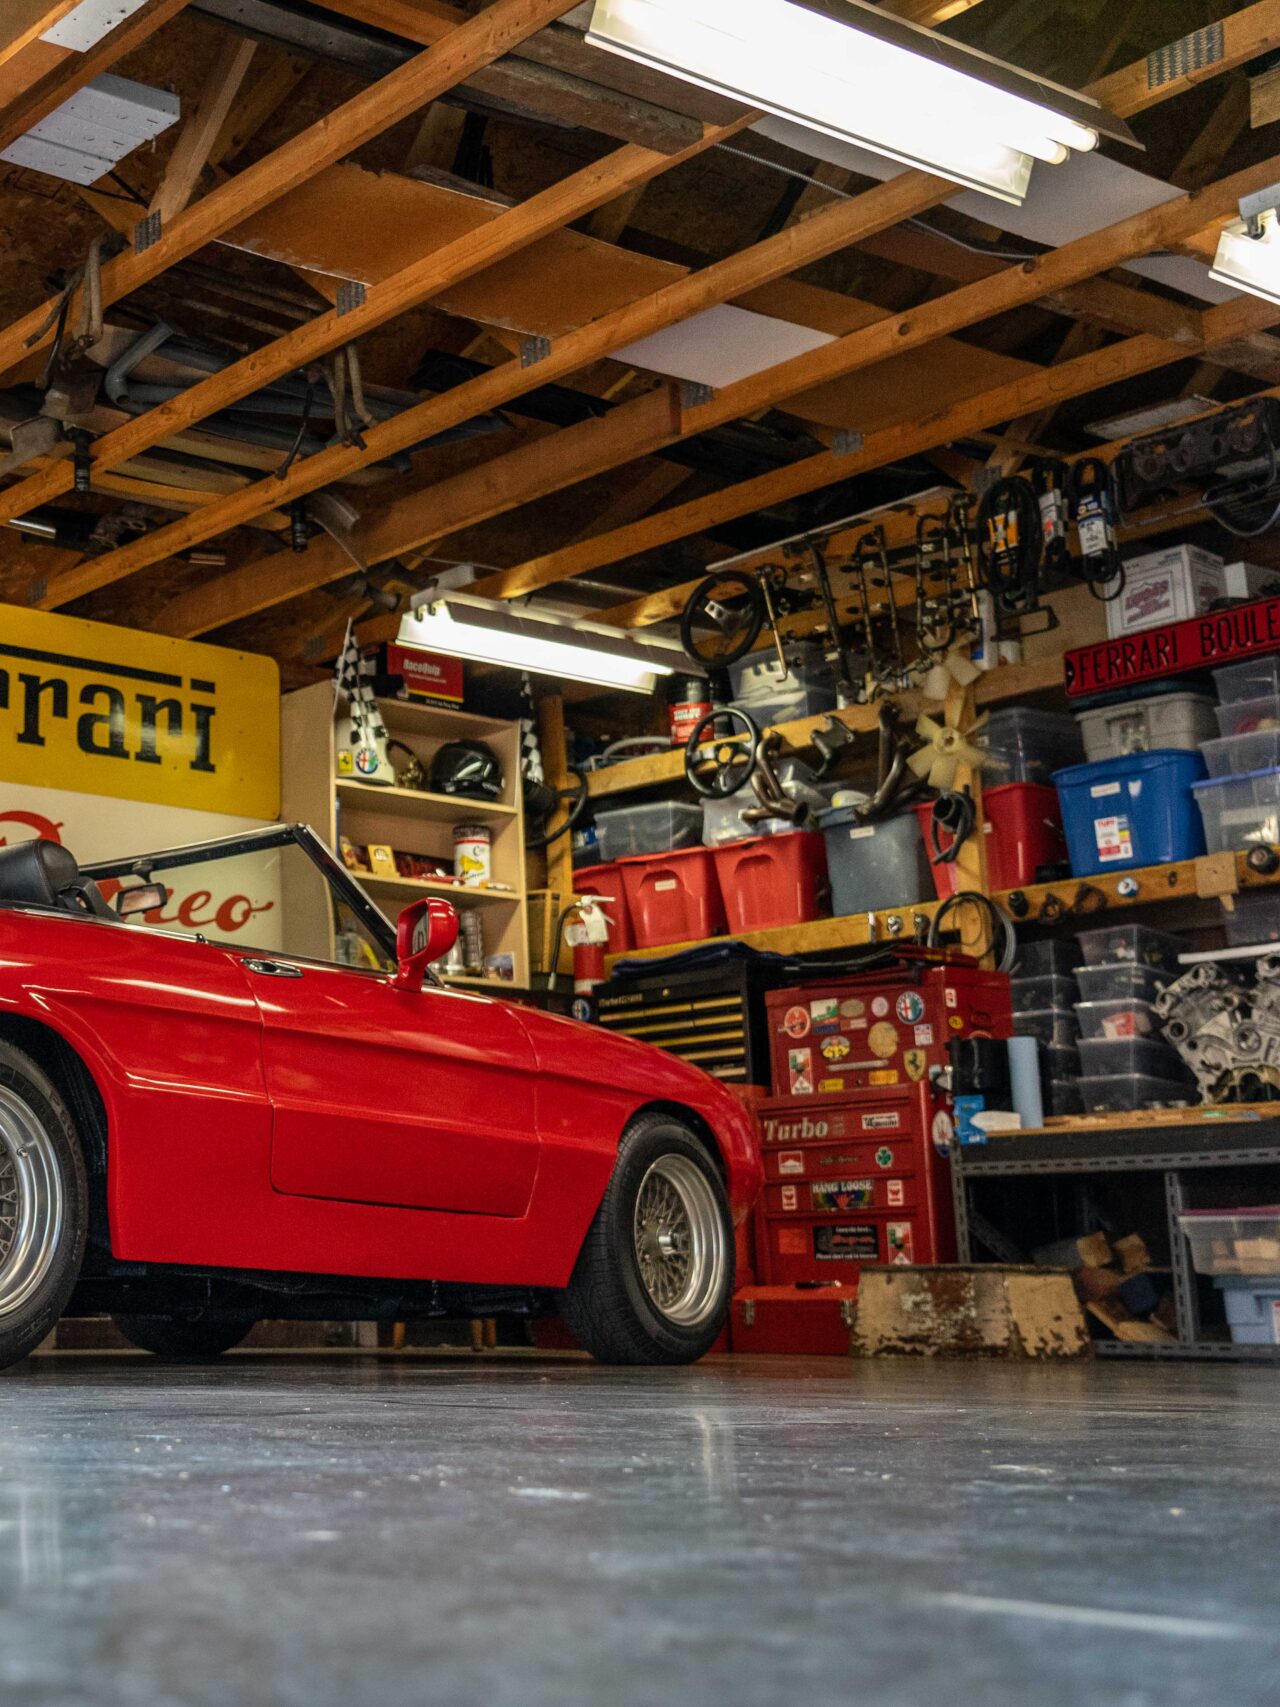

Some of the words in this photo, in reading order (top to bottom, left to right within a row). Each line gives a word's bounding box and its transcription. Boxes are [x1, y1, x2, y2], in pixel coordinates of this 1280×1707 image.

[1078, 629, 1179, 685] FERRARI
[763, 1117, 830, 1142] Turbo
[840, 1179, 873, 1193] LOOSE
